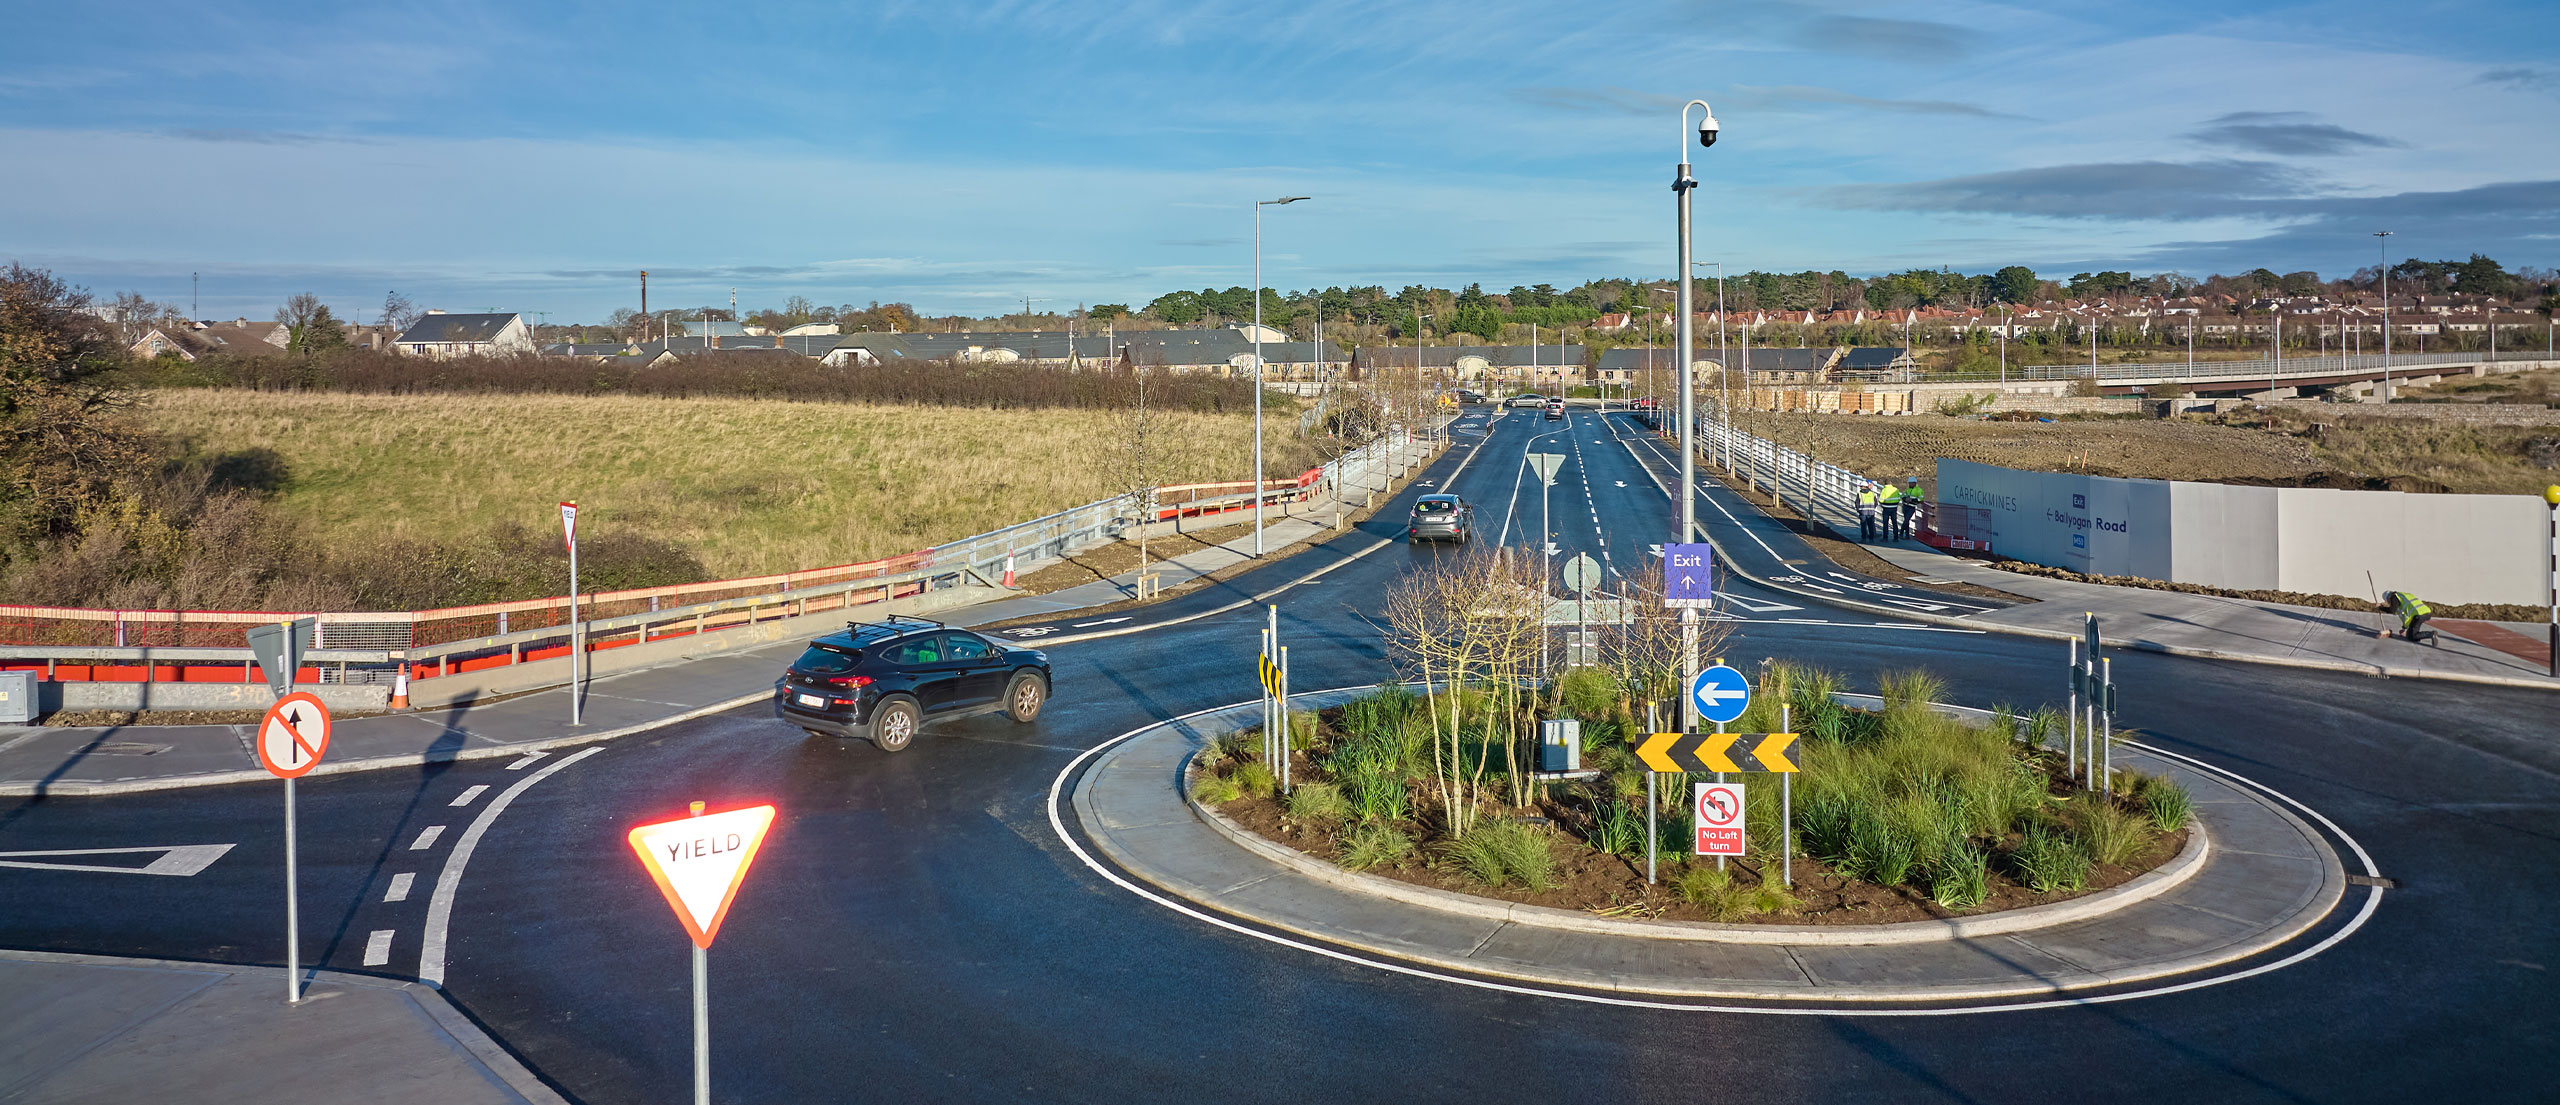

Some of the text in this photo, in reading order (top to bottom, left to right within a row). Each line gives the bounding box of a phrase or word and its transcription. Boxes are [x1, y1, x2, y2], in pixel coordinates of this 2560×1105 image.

[1954, 485, 2016, 512] CARRICKMINES
[2054, 510, 2127, 533] Ballyogan Road
[1673, 554, 1701, 567] Exit
[1702, 830, 1738, 840] No Left
[667, 833, 741, 862] YIELD
[1709, 842, 1730, 850] turn
